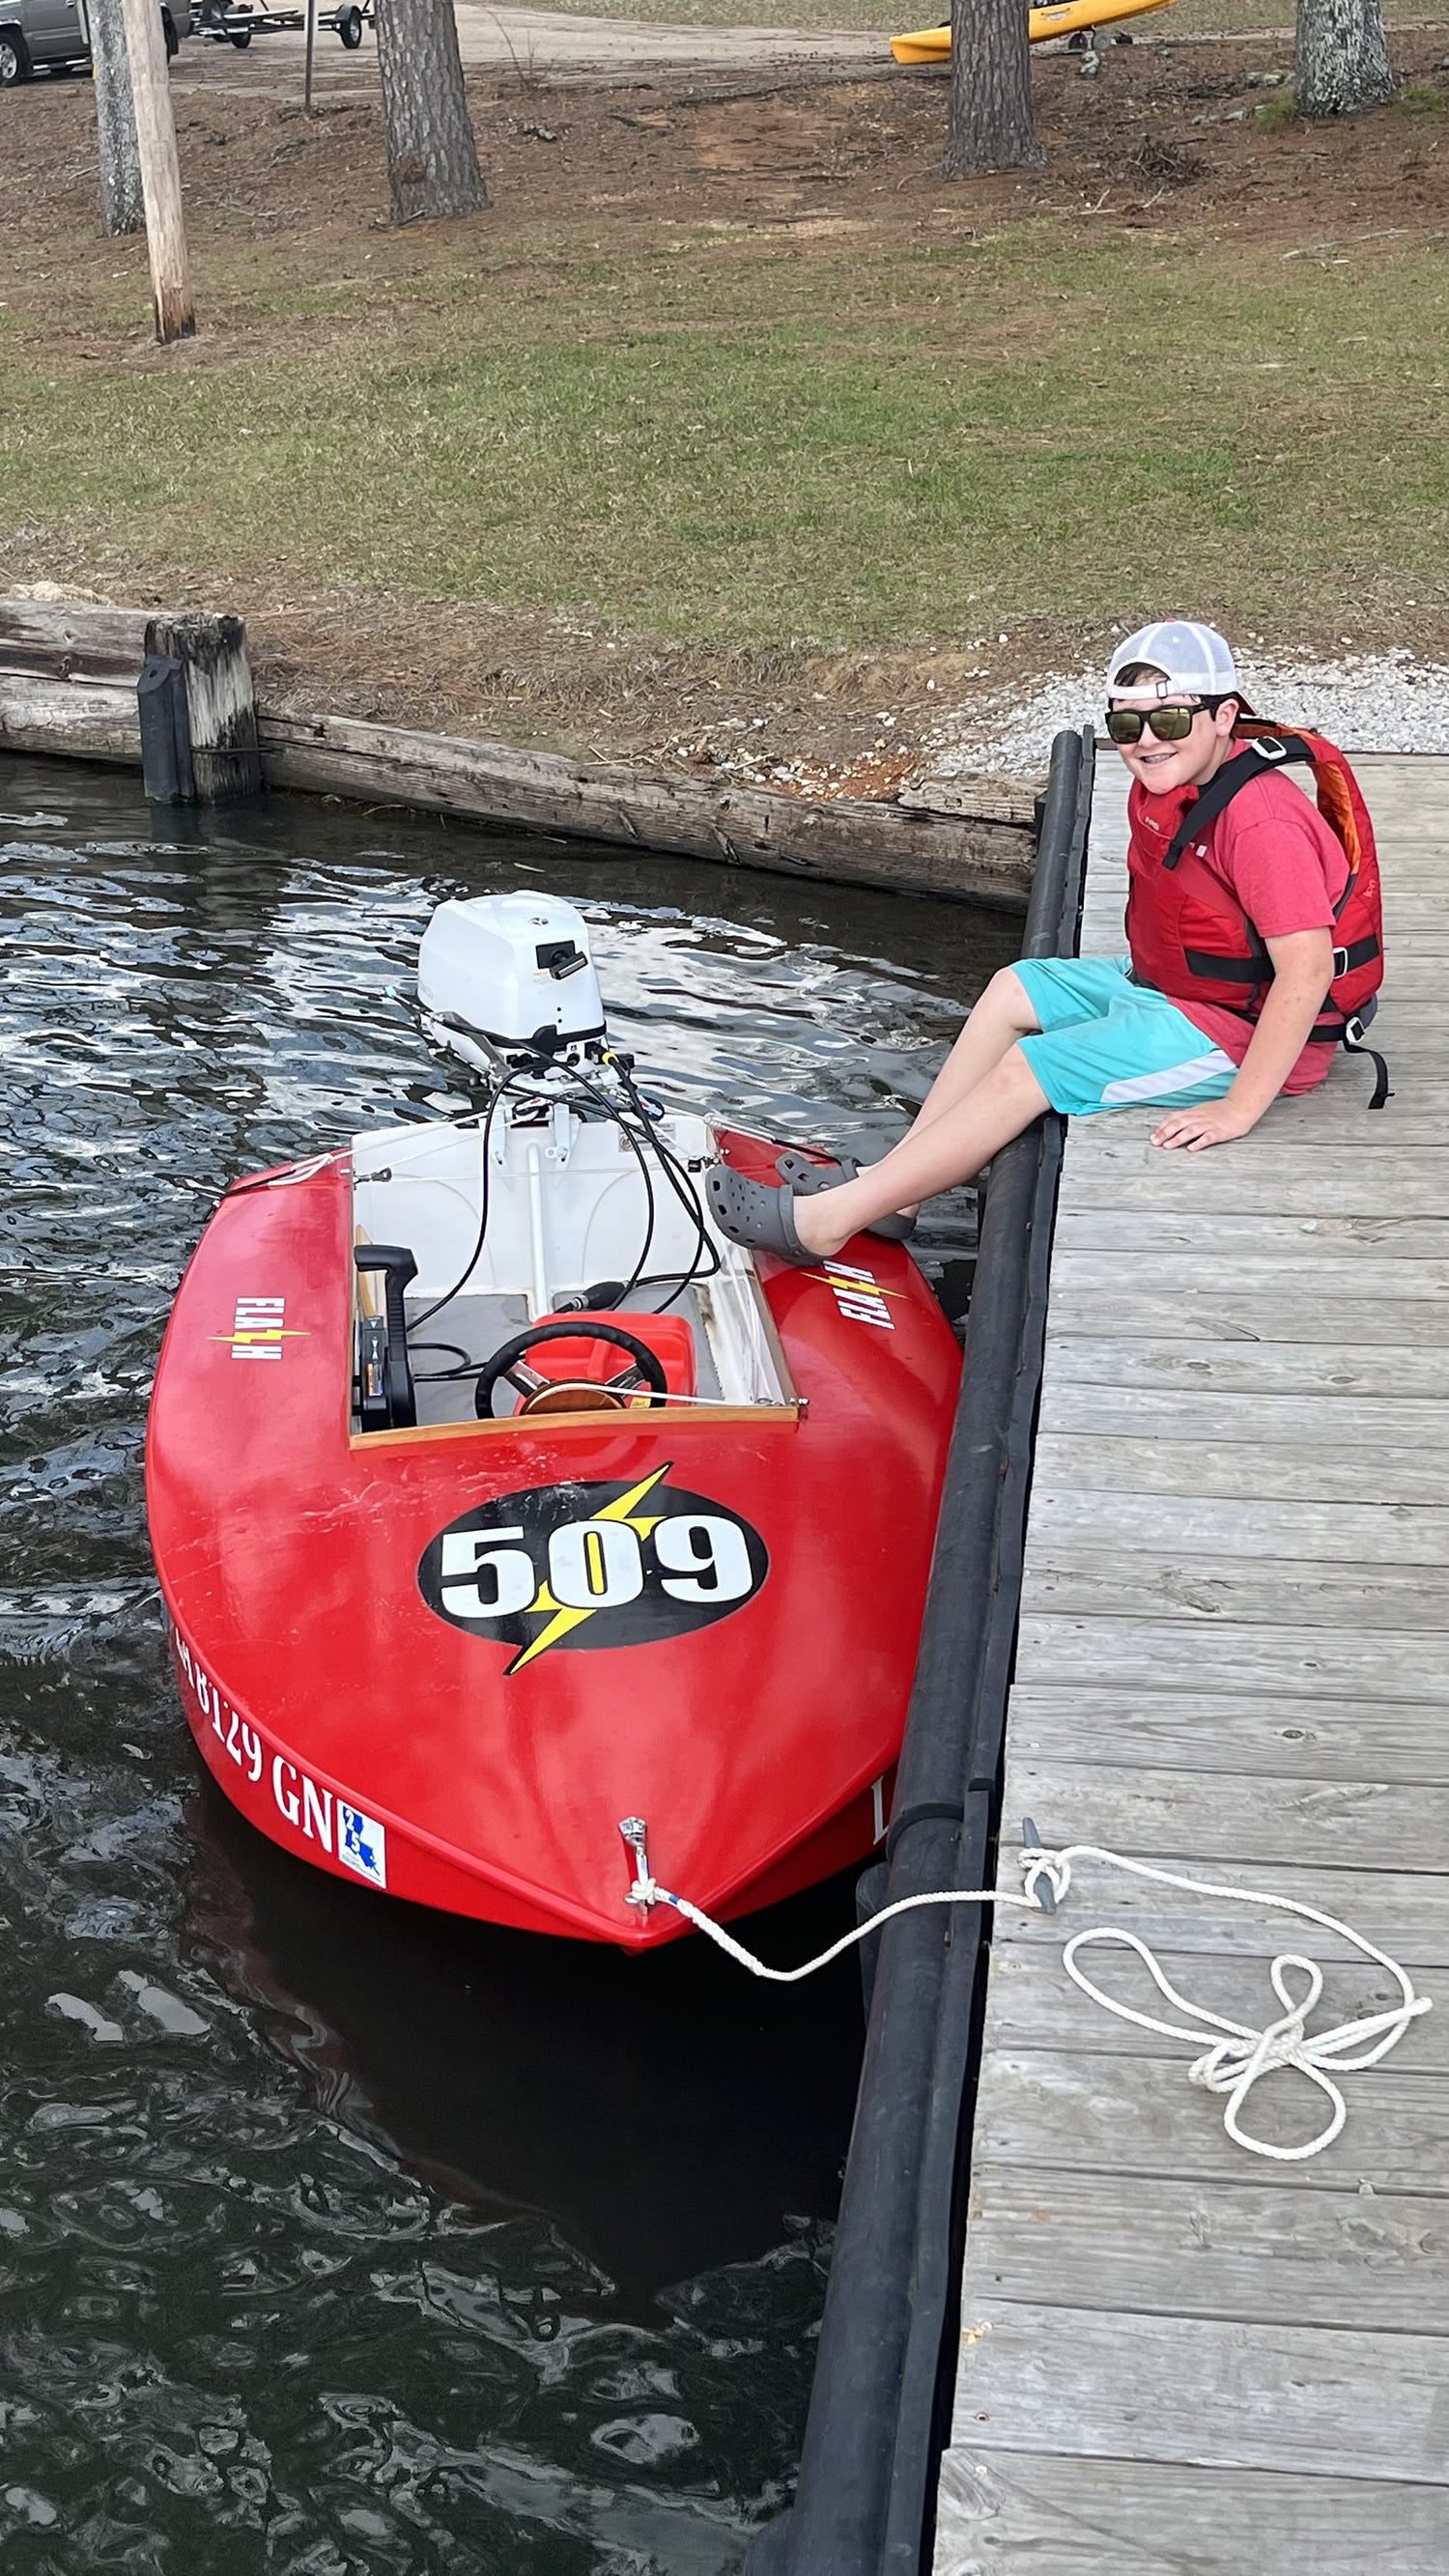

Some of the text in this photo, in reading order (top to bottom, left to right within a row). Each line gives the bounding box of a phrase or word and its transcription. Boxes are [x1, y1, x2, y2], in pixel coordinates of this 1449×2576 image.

[440, 1514, 753, 1618] 509
[194, 1661, 263, 1782] 8129
[271, 1754, 333, 1854] GN
